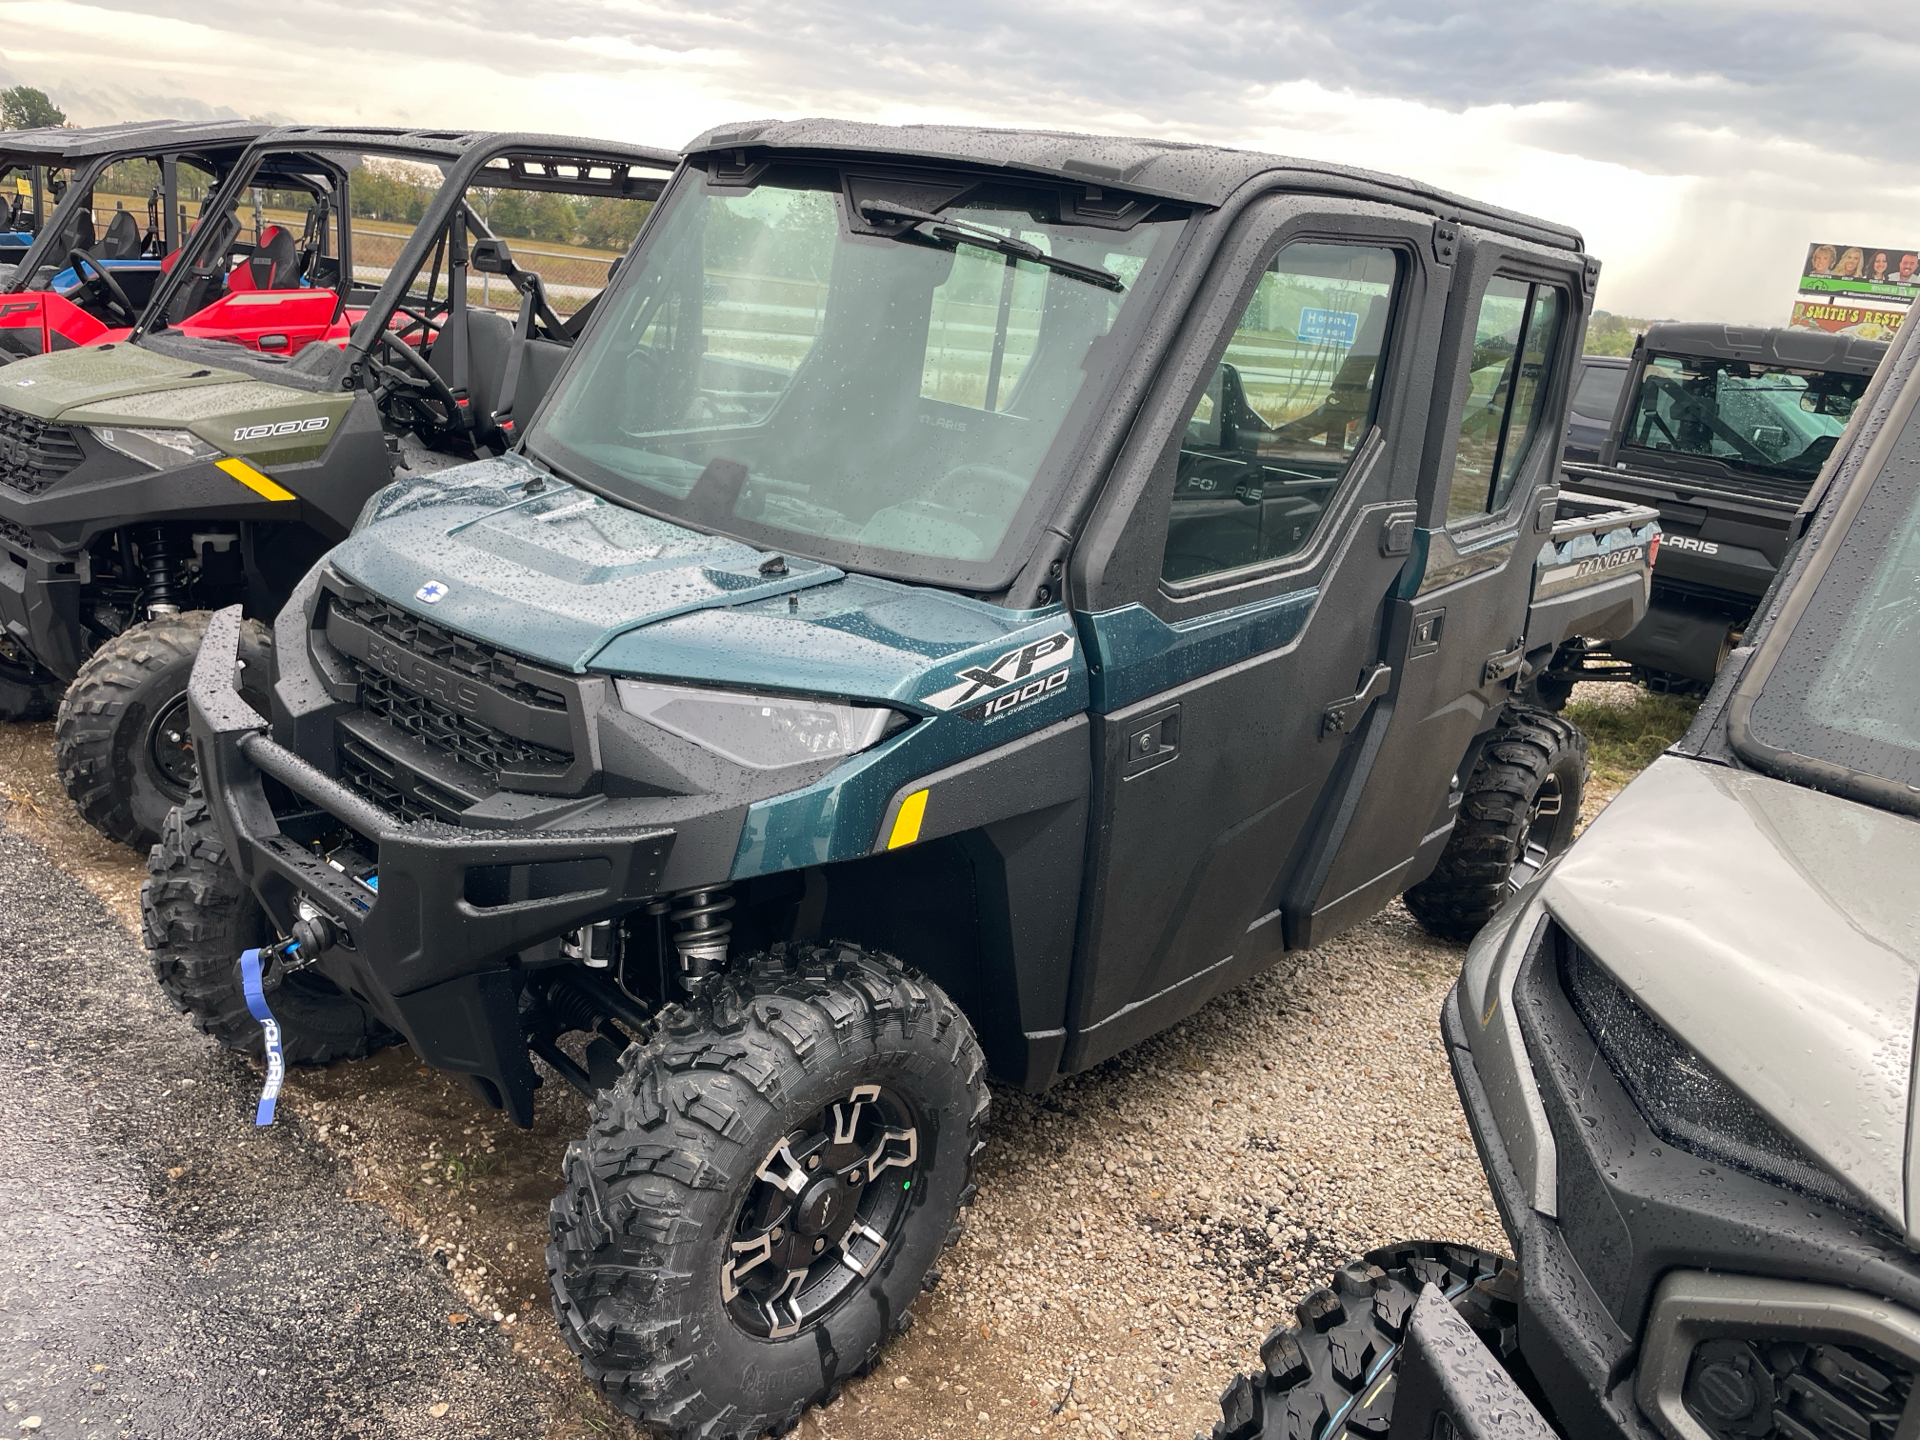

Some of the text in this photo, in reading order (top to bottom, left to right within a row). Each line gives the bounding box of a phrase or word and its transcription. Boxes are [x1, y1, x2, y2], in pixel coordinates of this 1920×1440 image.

[0, 302, 39, 317] P
[1806, 305, 1859, 323] SMITH'S
[233, 416, 330, 441] 1000
[919, 414, 968, 432] OLARIS
[1660, 533, 1719, 555] LARIS
[1574, 547, 1640, 579] RANGER
[367, 635, 480, 713] POLARIS
[949, 630, 1074, 711] XP
[984, 667, 1071, 718] 1000
[260, 1018, 283, 1101] POLARIS
